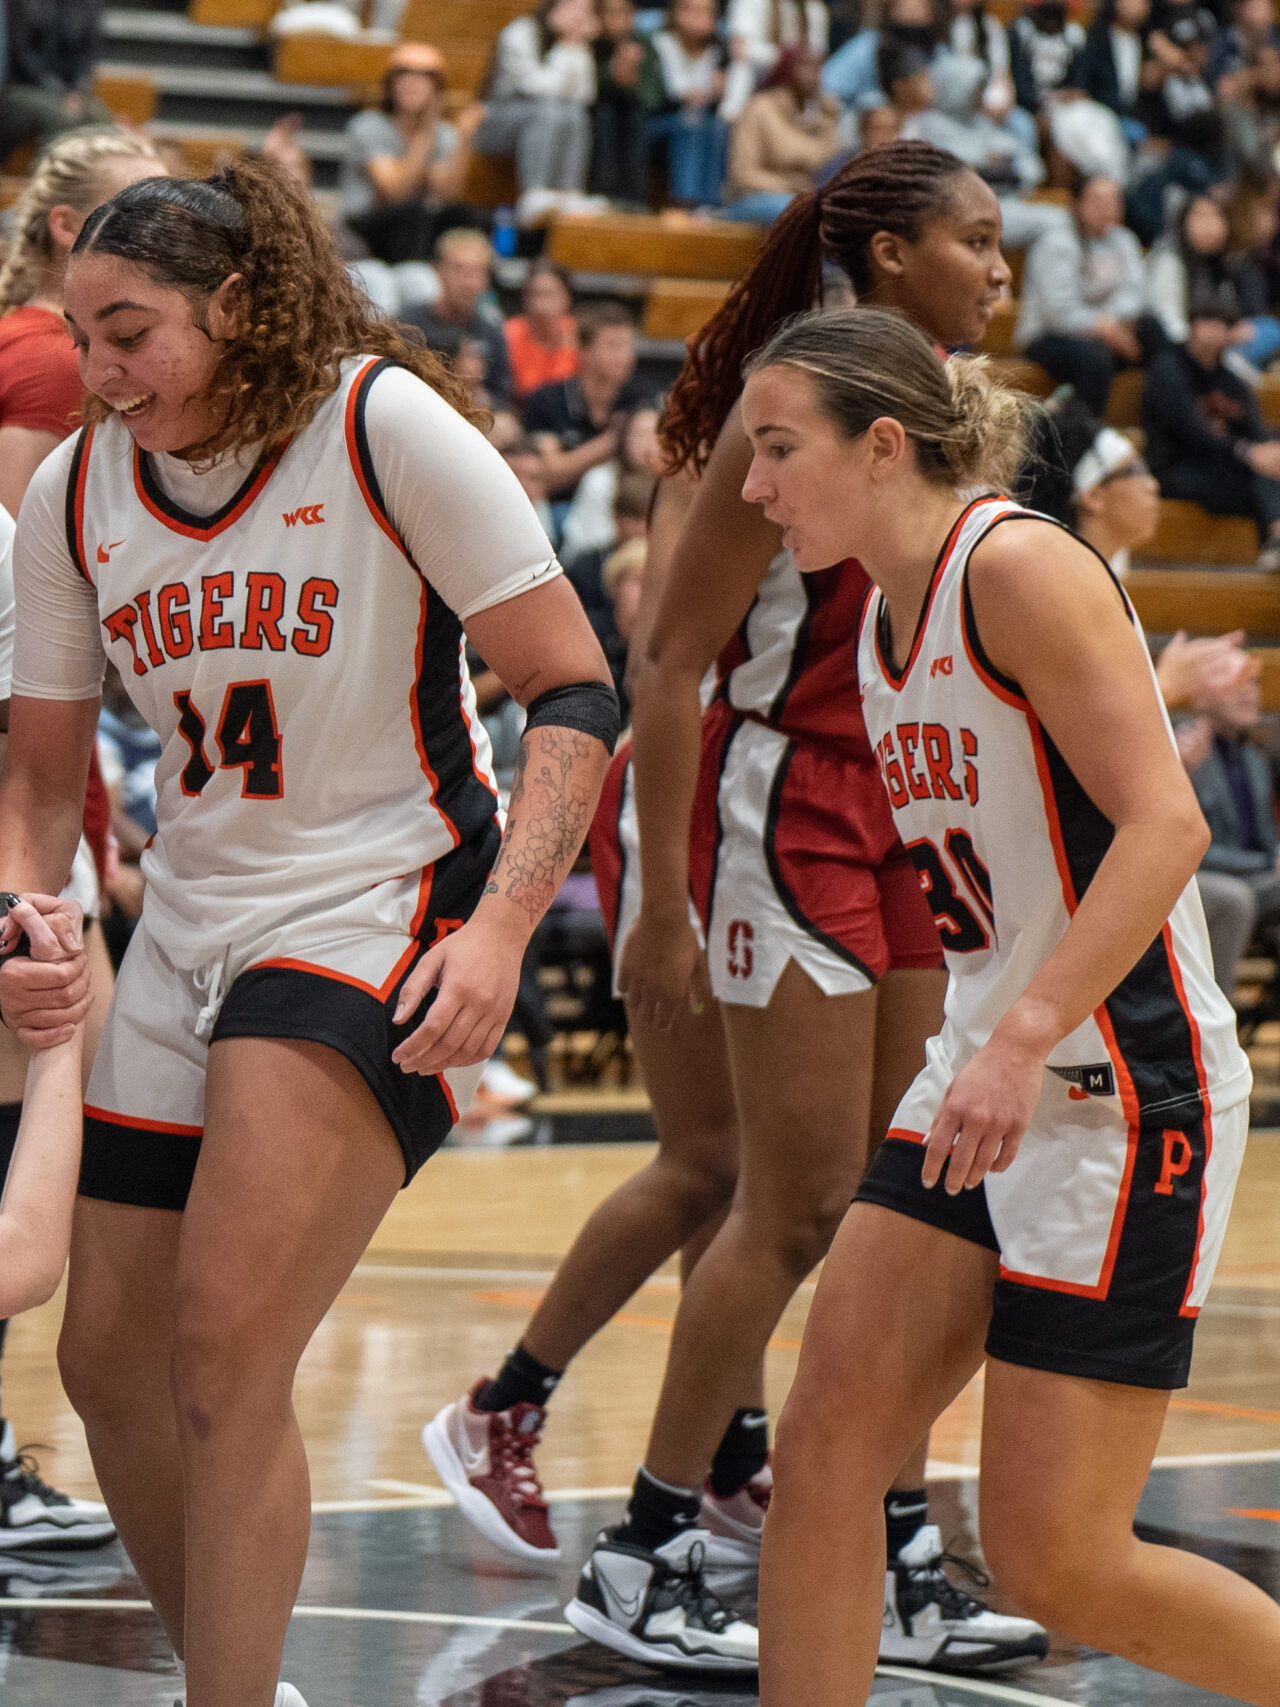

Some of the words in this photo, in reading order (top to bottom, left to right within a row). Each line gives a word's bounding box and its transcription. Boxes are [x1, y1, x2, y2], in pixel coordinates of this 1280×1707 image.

[281, 503, 325, 528] WCC
[101, 571, 339, 676] TIGERS
[172, 678, 284, 800] 14
[1089, 1073, 1103, 1088] M
[1154, 1128, 1192, 1196] P
